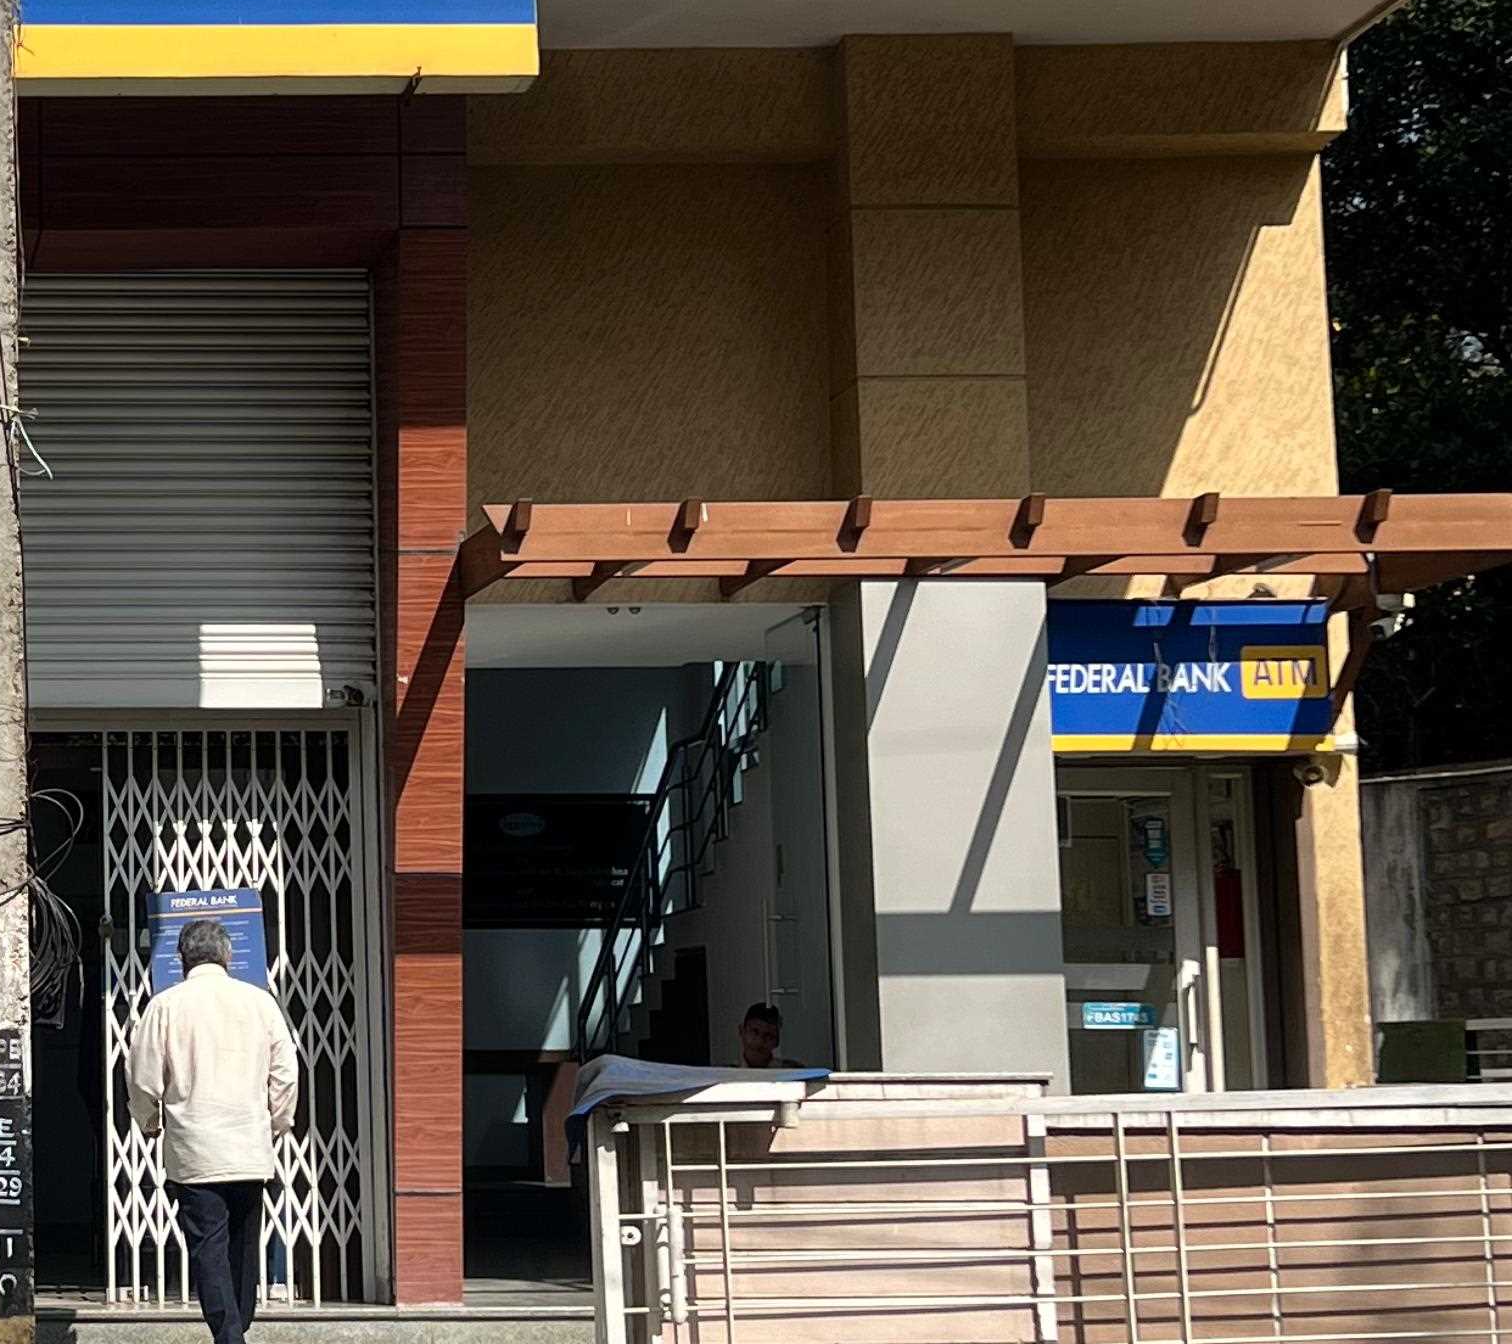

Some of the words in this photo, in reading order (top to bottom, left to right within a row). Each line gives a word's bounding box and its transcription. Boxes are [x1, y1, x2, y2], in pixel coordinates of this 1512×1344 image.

[1047, 662, 1150, 694] FEDERAL
[1156, 662, 1232, 694] BANK
[1253, 657, 1317, 687] ATM
